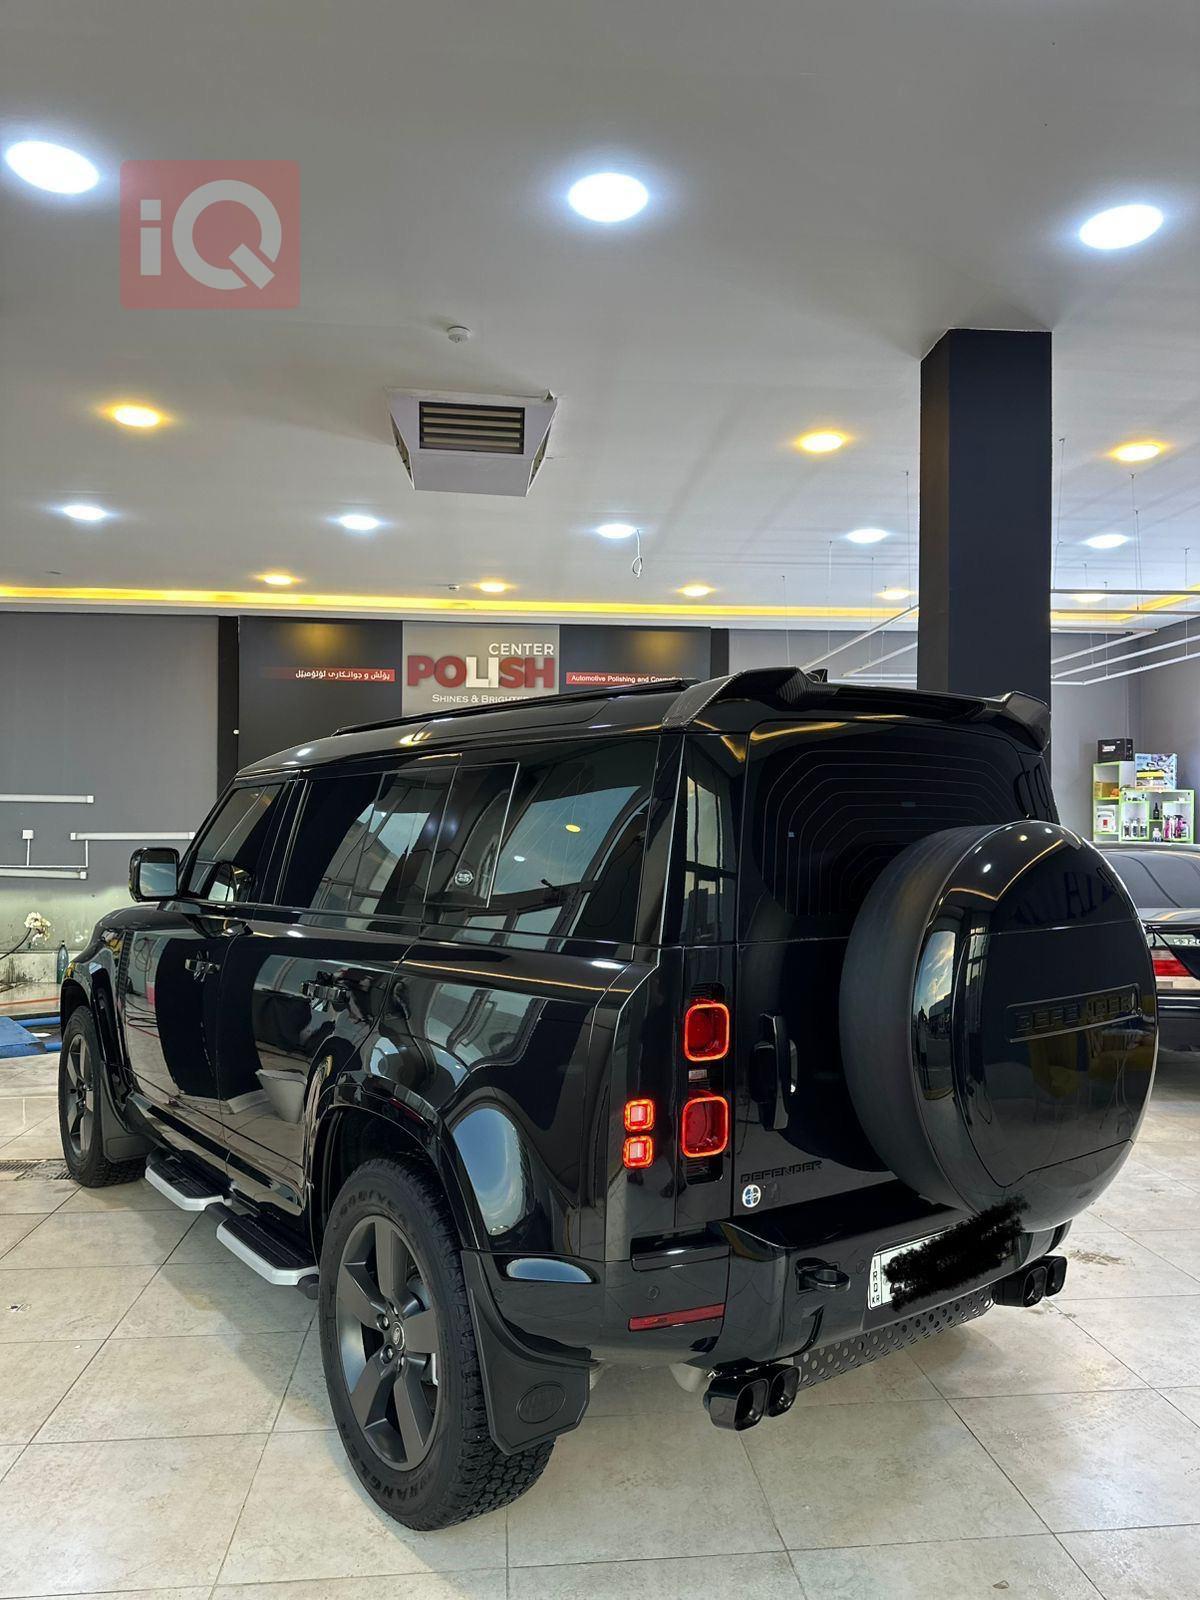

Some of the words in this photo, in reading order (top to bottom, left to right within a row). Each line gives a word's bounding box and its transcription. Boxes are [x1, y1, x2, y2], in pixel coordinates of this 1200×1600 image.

[488, 643, 554, 655] CENTER
[407, 655, 555, 688] POLISH
[607, 675, 636, 684] Polishing
[432, 693, 468, 703] SHINES
[470, 694, 479, 703] &
[740, 1160, 823, 1184] DEFENDER
